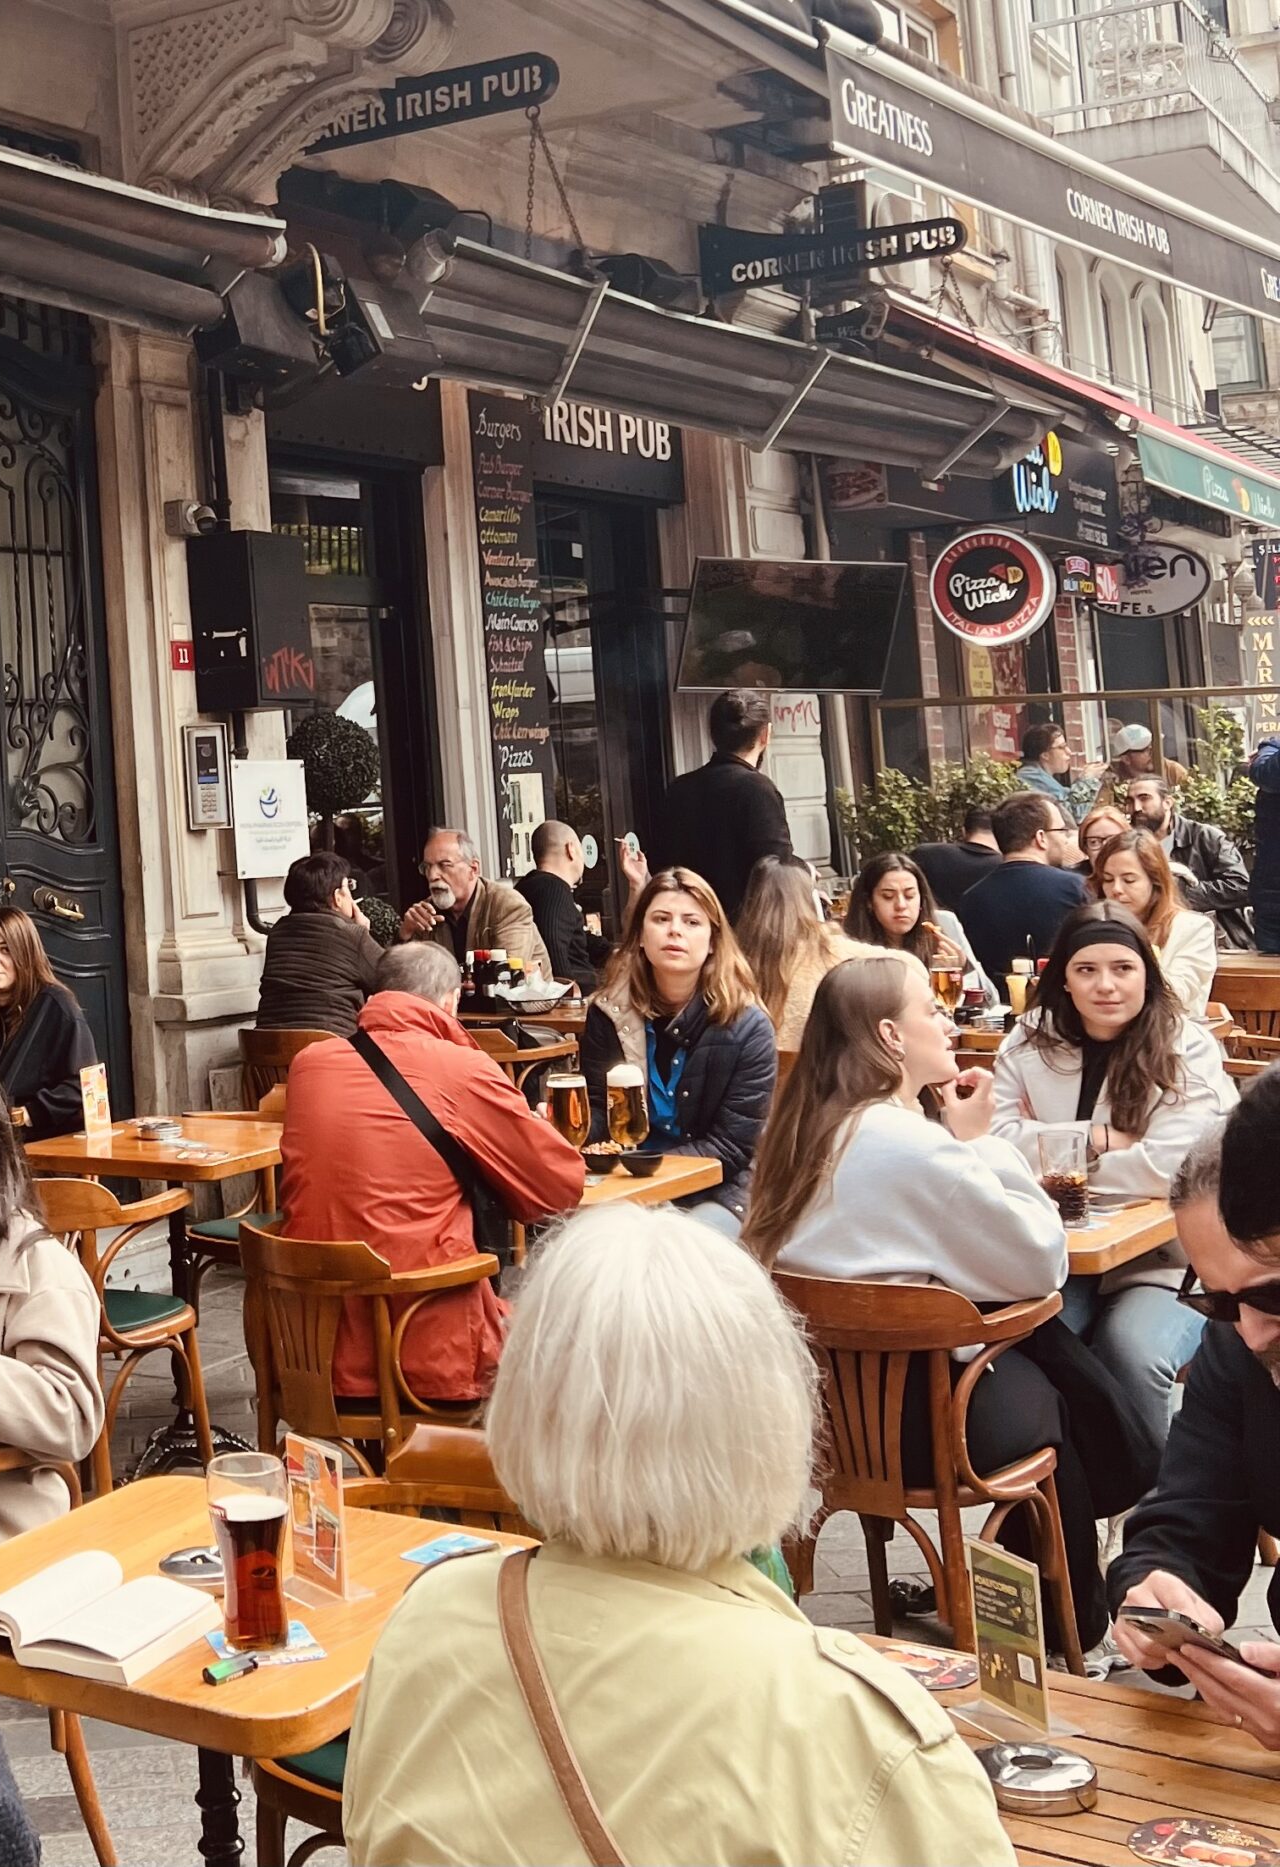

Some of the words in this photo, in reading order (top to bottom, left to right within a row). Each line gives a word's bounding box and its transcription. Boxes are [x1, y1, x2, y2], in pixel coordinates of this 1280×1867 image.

[397, 81, 471, 121] IRISH
[483, 65, 542, 102] PUB
[841, 79, 934, 157] GREATNESS
[905, 225, 956, 253] PUB
[1067, 188, 1116, 234] CORNER
[1115, 209, 1147, 246] IRISH
[1146, 222, 1170, 254] PUB
[475, 408, 521, 449] Burgers
[544, 400, 614, 452] IRISH
[619, 413, 672, 461] PUB
[1013, 463, 1058, 513] Wich
[1203, 465, 1229, 503] Pizza
[1250, 488, 1275, 519] Wich
[485, 591, 519, 608] Chicken
[949, 573, 1001, 598] Pizza
[964, 582, 1018, 611] Wich
[485, 611, 511, 632] Main
[946, 611, 1002, 637] ITALIAN
[1006, 596, 1040, 631] PIZZA
[179, 649, 190, 663] 11
[492, 702, 520, 724] Wraps
